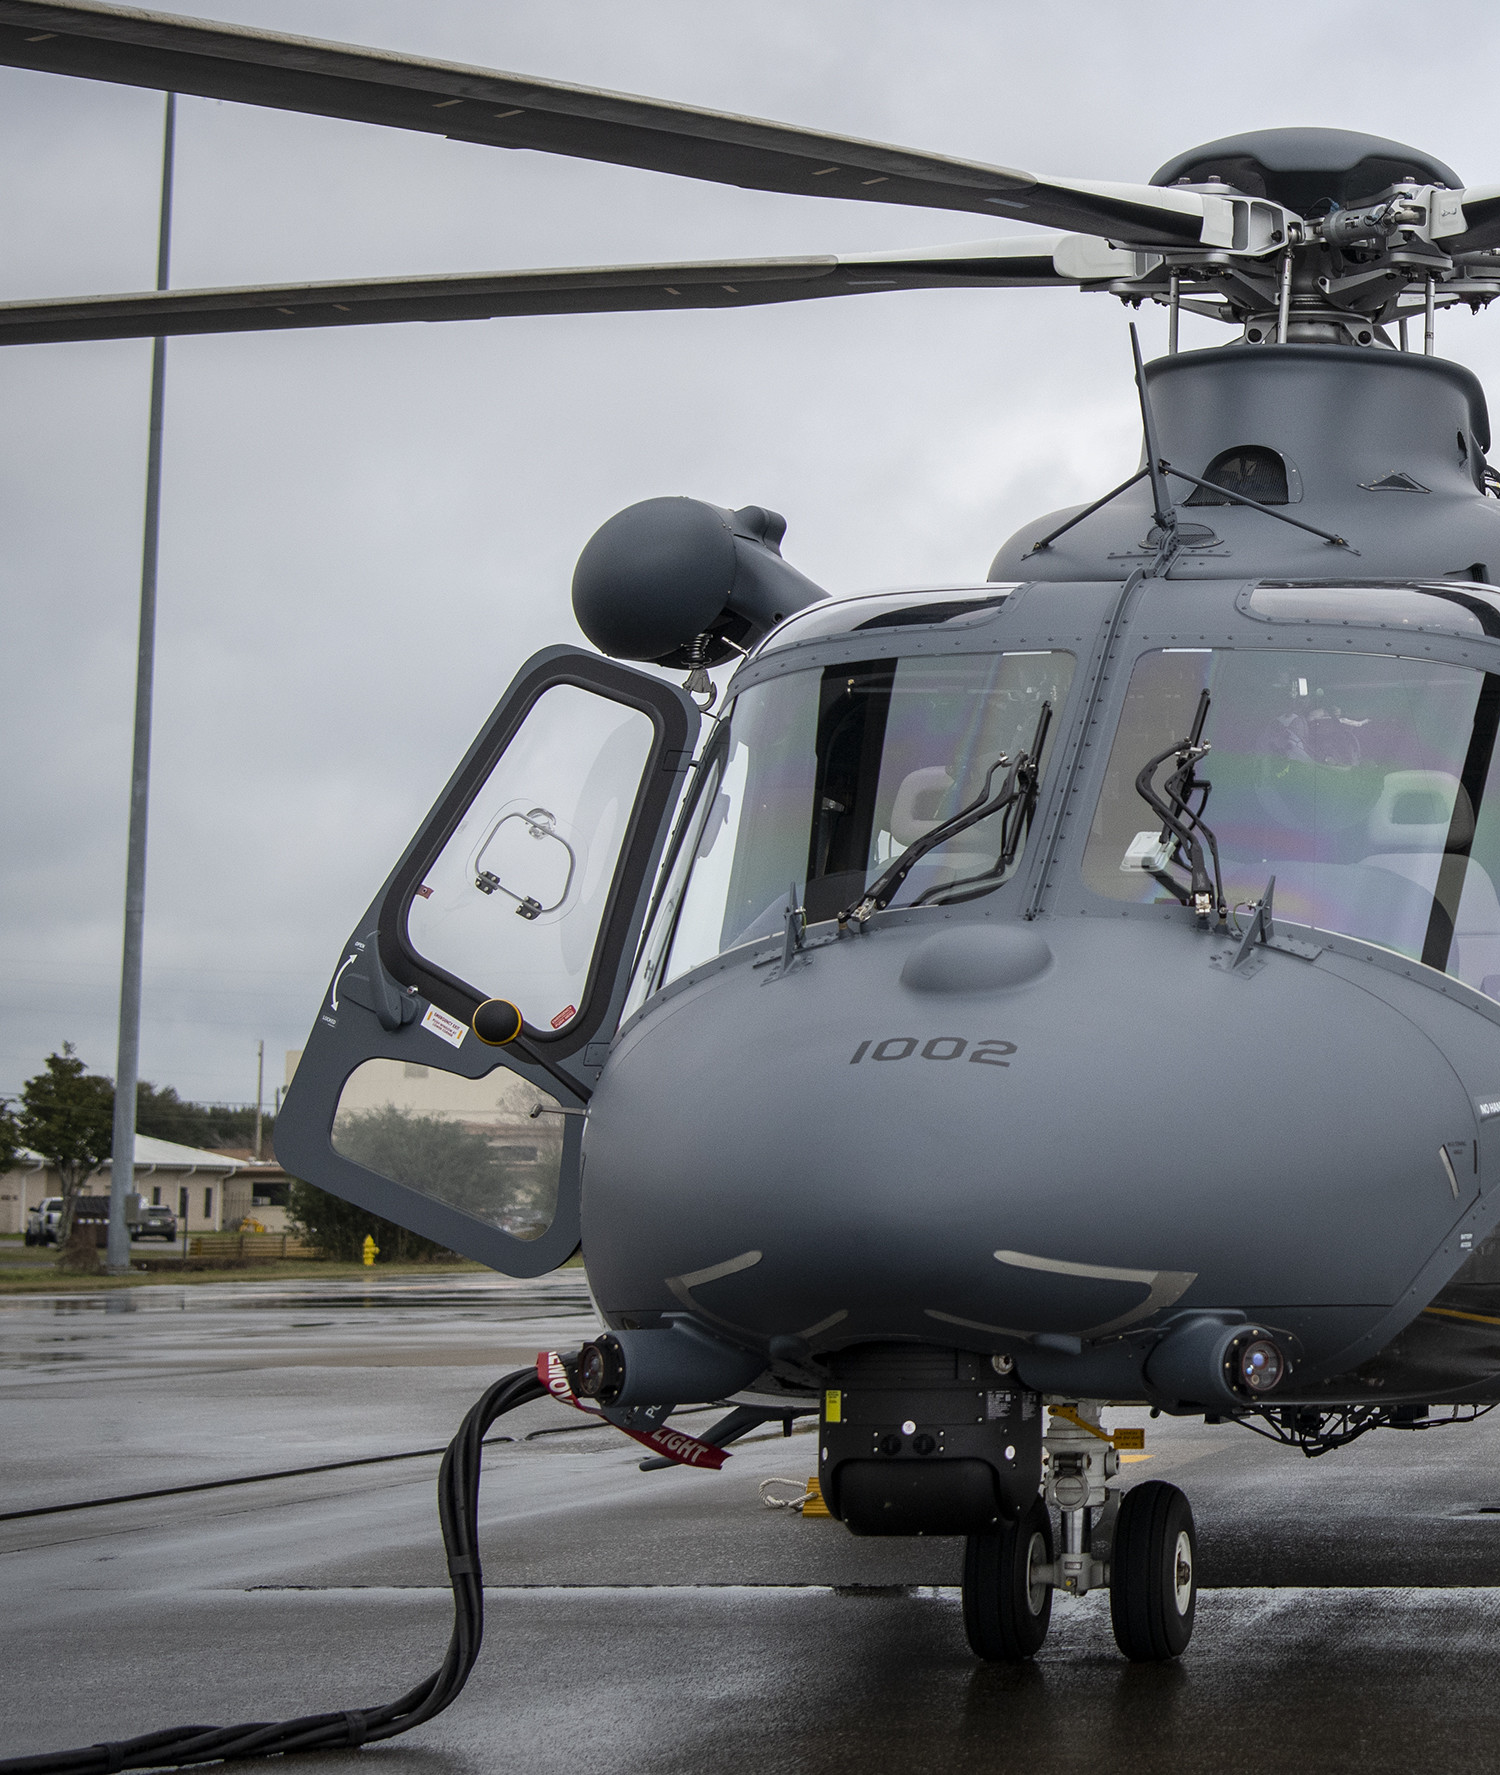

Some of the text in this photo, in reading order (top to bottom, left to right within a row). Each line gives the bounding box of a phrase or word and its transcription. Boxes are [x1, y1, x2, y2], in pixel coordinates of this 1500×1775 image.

[354, 941, 366, 949] OPEN
[322, 1015, 337, 1025] LOCKED
[433, 1012, 453, 1026] EMERGENCY
[850, 1036, 1018, 1068] 1002
[1479, 1103, 1490, 1114] NO
[548, 1351, 574, 1405] EMOV
[651, 1428, 709, 1463] LIGHT
